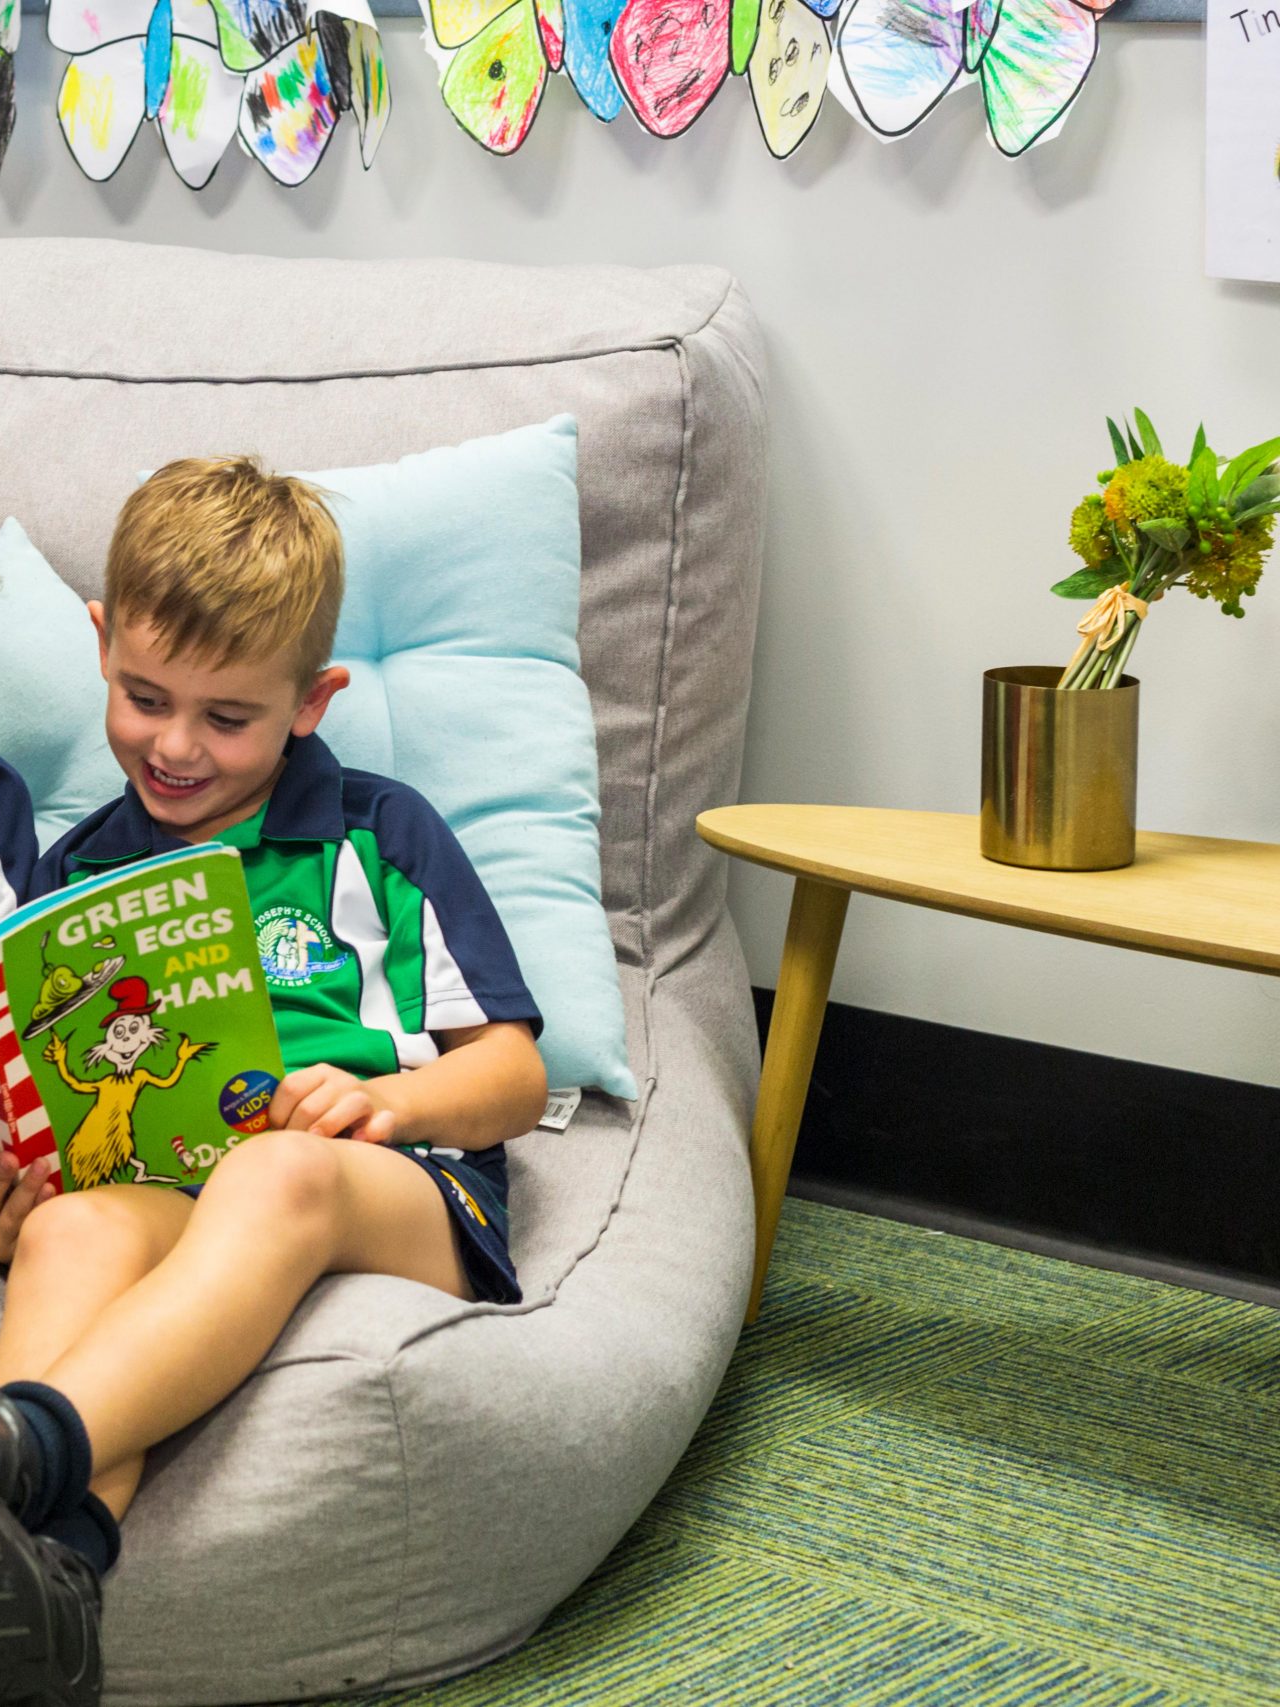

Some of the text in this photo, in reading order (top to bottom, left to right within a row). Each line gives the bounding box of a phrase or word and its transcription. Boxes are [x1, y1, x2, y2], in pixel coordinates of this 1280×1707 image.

[57, 872, 208, 947] GREEN
[134, 907, 234, 956] EGGS
[255, 906, 333, 949] JOSEPH'S SCHOOL
[164, 943, 230, 978] AND
[152, 968, 254, 1015] HAM
[246, 1114, 268, 1132] TOP
